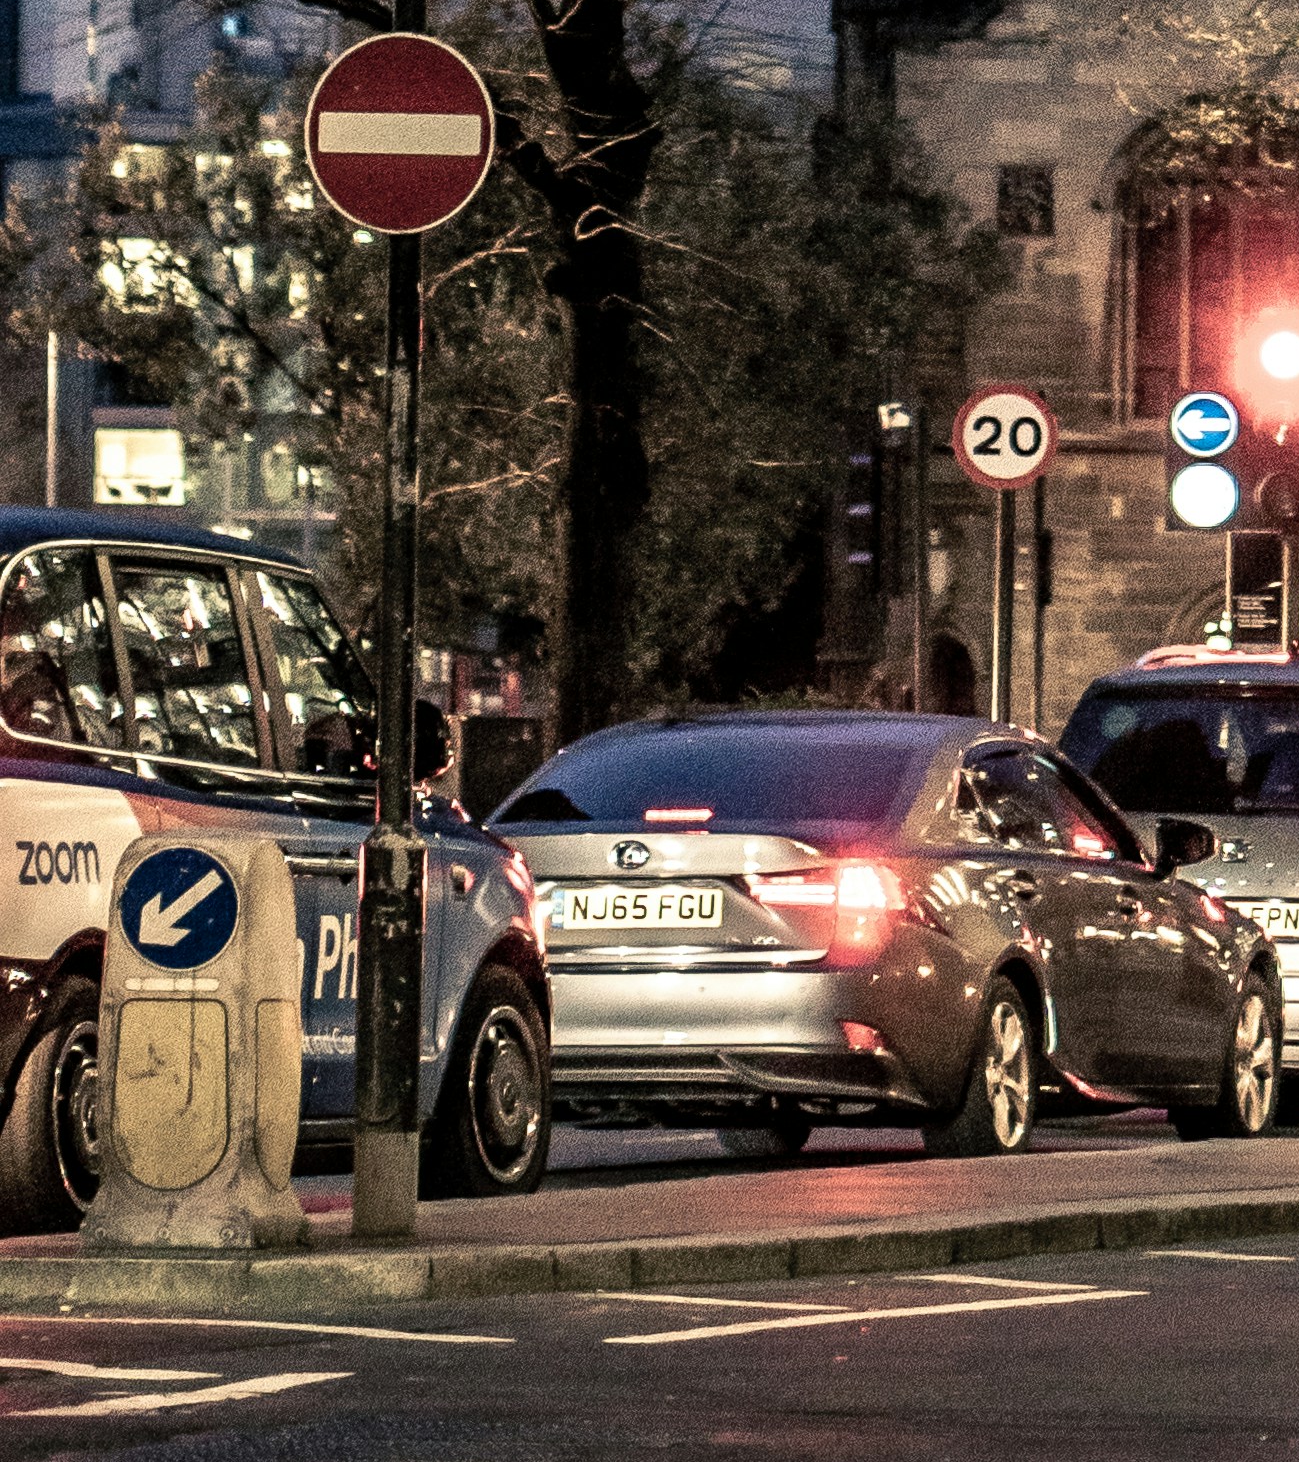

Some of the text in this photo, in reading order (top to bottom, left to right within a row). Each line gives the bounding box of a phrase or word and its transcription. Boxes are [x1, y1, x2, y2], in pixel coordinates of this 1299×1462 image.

[972, 416, 1042, 457] 20
[16, 841, 100, 885] zoom
[572, 894, 716, 920] NJ65 FGU
[314, 913, 359, 1000] Ph
